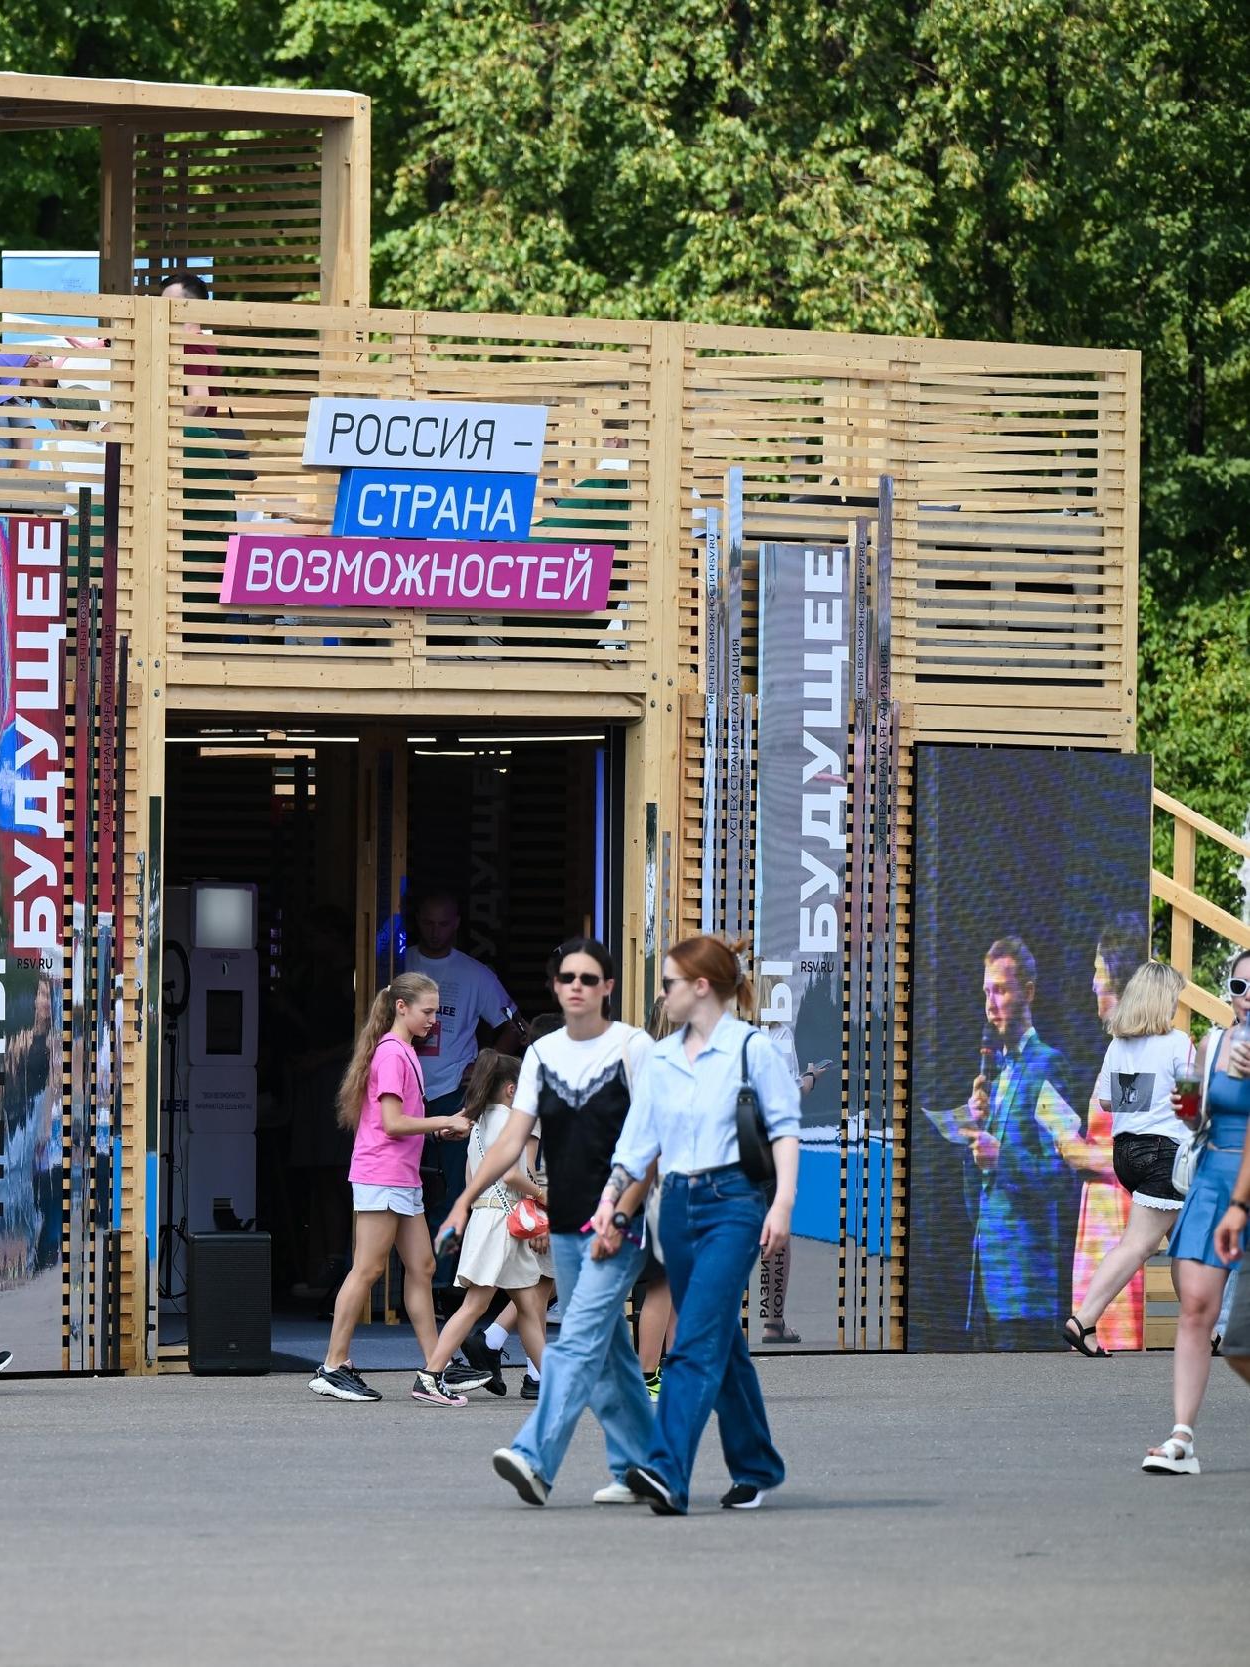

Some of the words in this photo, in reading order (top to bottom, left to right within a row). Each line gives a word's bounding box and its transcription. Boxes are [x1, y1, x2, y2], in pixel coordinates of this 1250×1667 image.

[329, 412, 496, 461] РОССИЯ
[357, 482, 517, 533] СТРАНА
[245, 547, 594, 601] ВОЗМОЖНОСТЕЙ
[708, 533, 716, 571] RSV.RU
[708, 573, 716, 663] ВОЗМОЖНОСТИ
[857, 580, 865, 669] ВОЗМОЖНОСТИ
[104, 624, 113, 723] РЕАЛИЗАЦИЯ
[708, 665, 716, 705] МЕЧТЫ
[731, 638, 741, 732] РЕАЛИЗАЦИЯ
[856, 671, 864, 711] МЕЧТЫ
[880, 644, 889, 738] РЕАЛИЗАЦИЯ
[14, 522, 67, 948] БУДУЩЕЕ
[103, 725, 112, 784] СТРАНА
[799, 550, 849, 953] БУДУЩЕЕ
[730, 735, 739, 791] СТРАНА
[878, 741, 887, 796] СТРАНА
[103, 787, 111, 834] УСПЕХ
[729, 794, 738, 840] УСПЕХ
[878, 799, 887, 844] УСПЕХ
[17, 957, 54, 970] RSV.RU
[800, 961, 835, 973] RSV.RU
